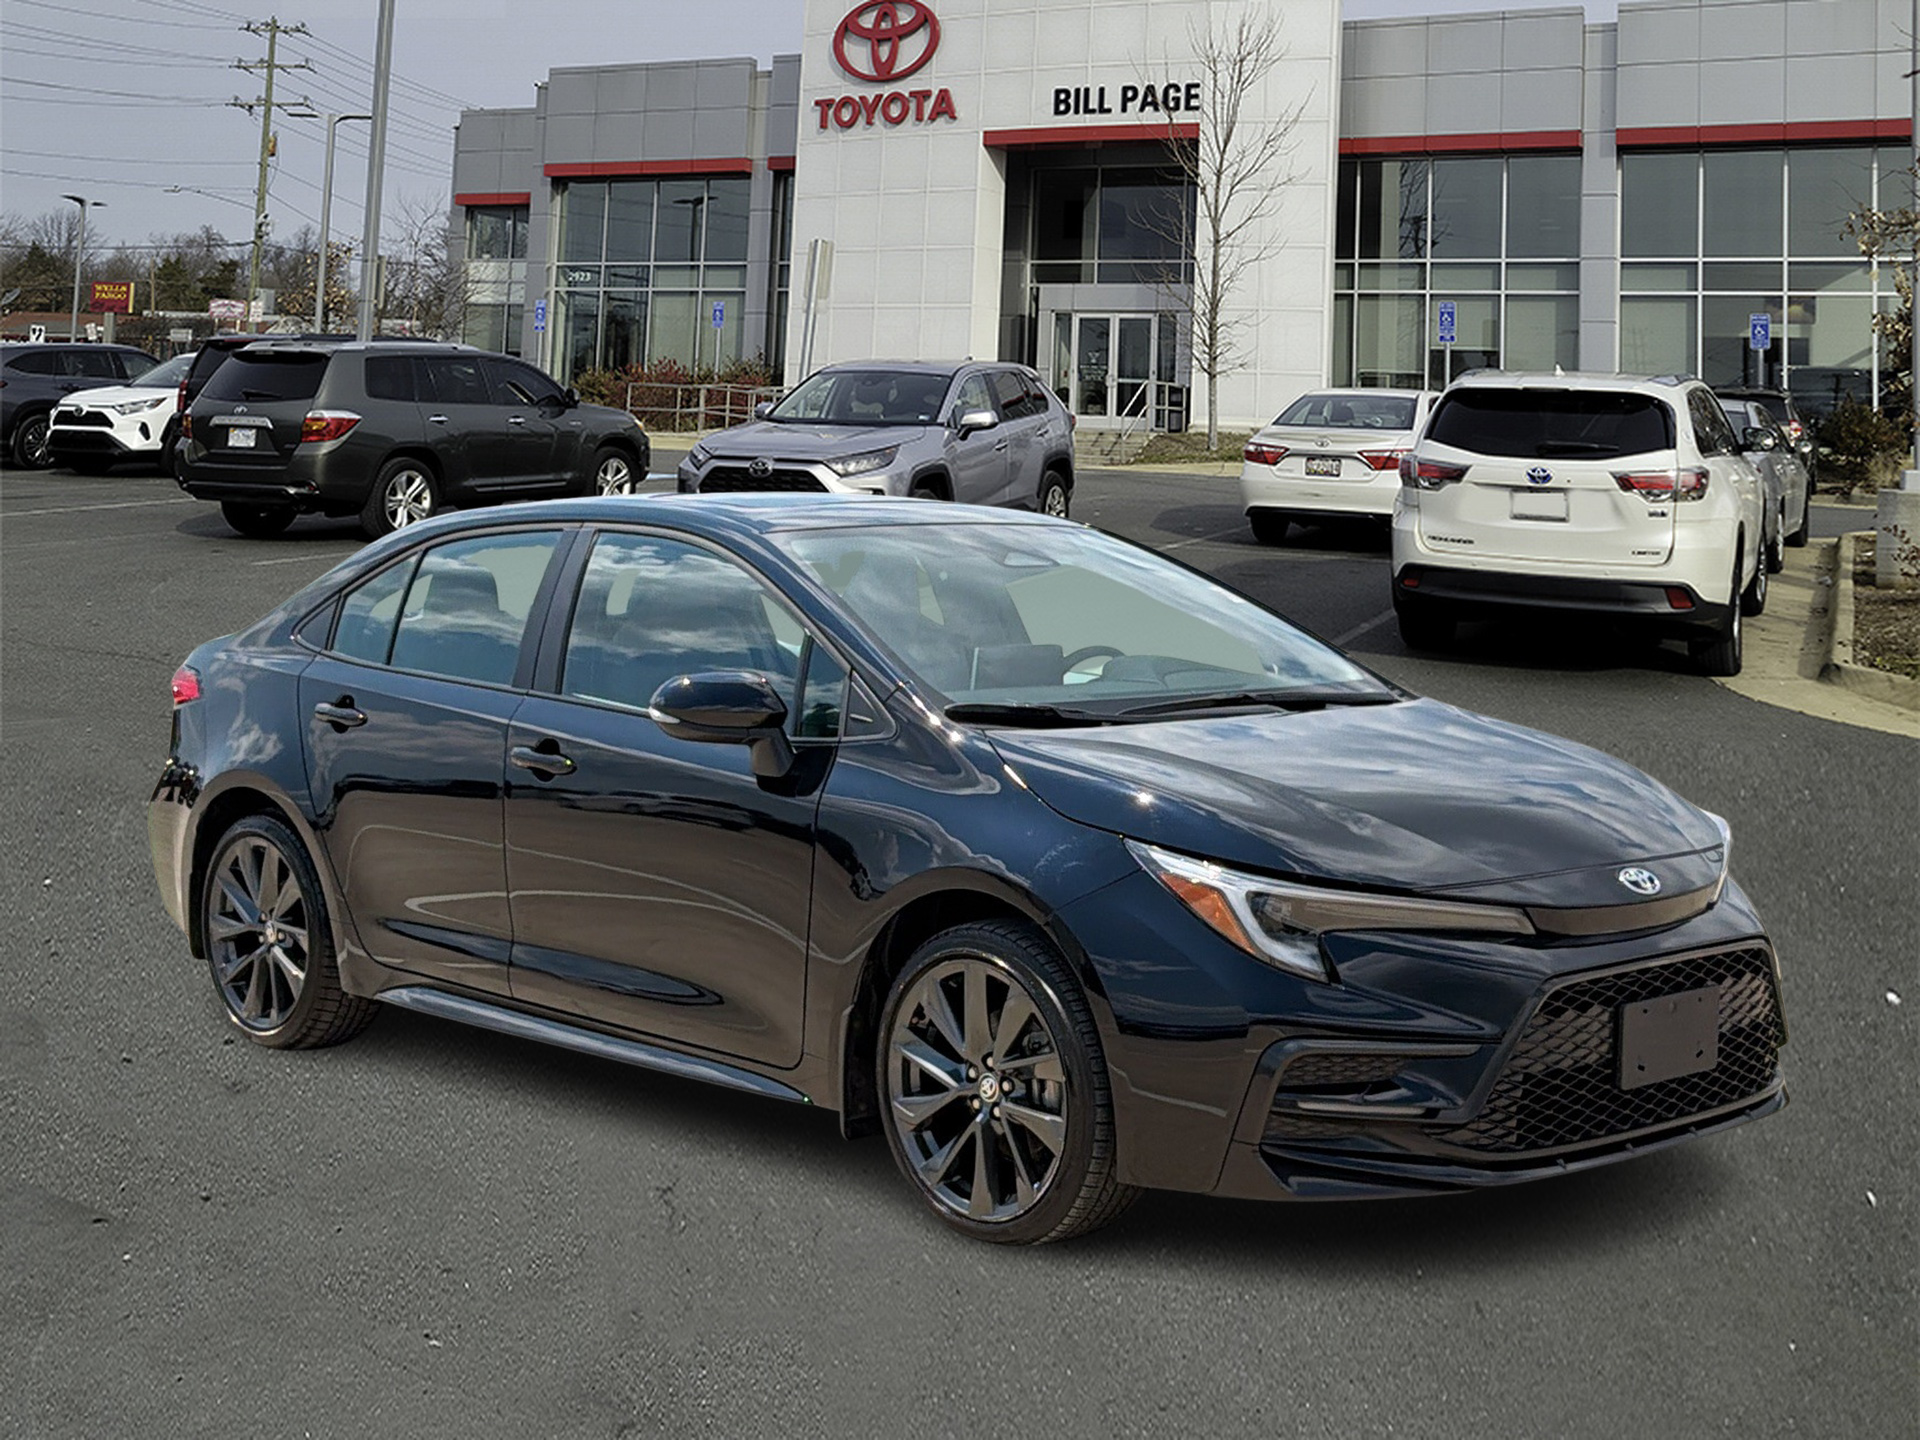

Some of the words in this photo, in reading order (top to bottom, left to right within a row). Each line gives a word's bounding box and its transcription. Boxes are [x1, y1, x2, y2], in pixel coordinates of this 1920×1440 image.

[814, 88, 957, 130] TOYOTA
[1053, 86, 1112, 116] BILL
[1120, 82, 1201, 113] PAGE
